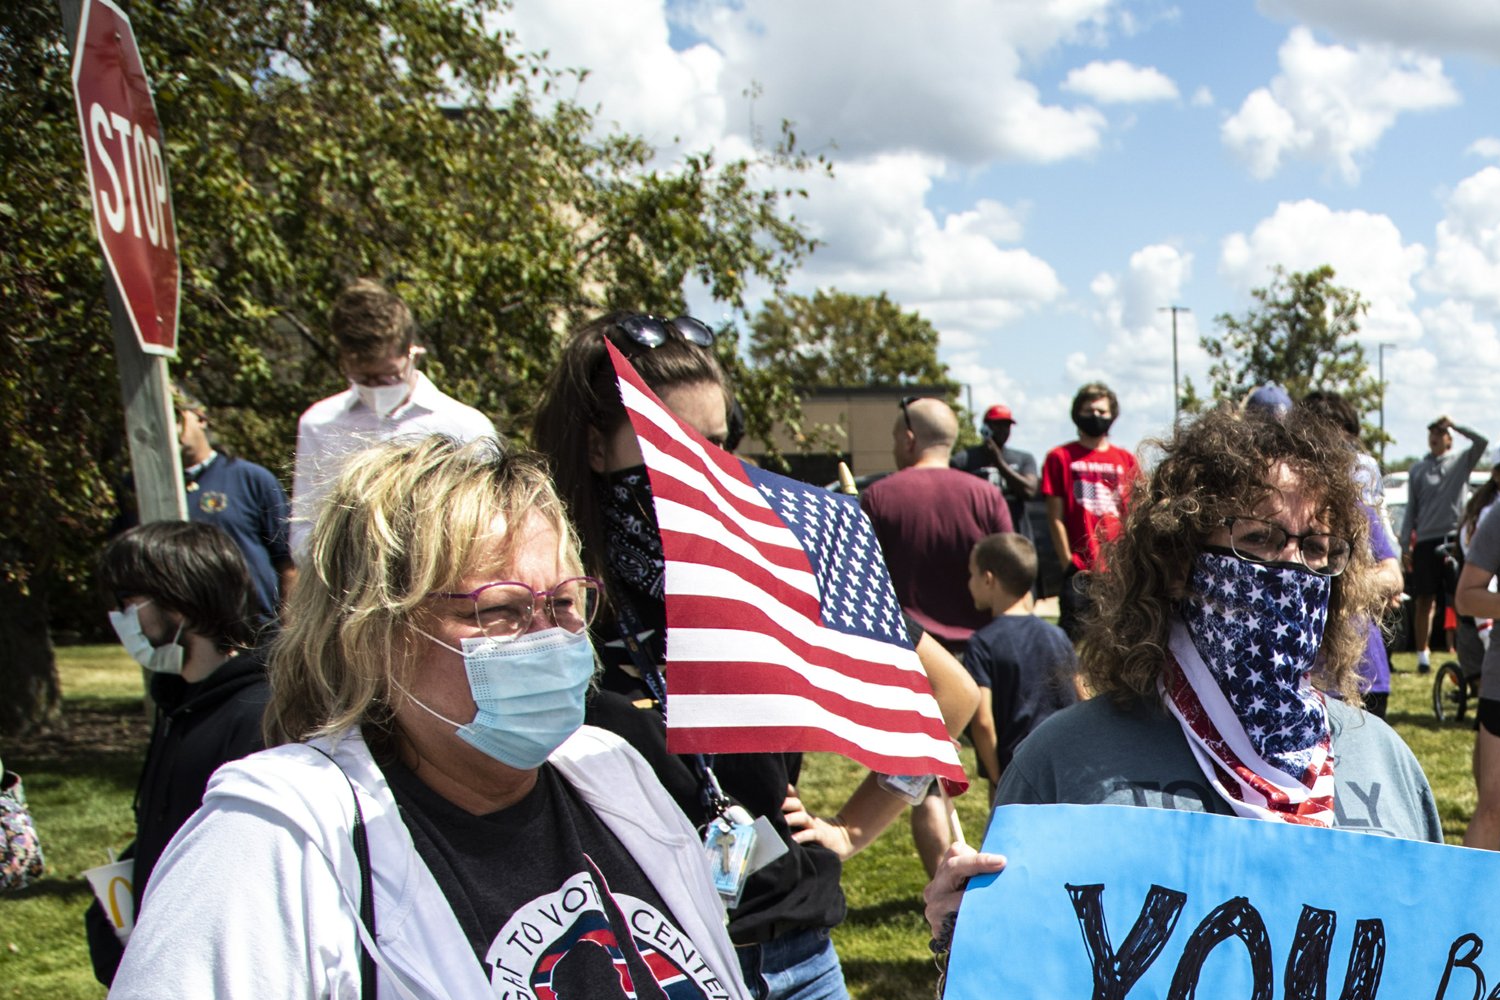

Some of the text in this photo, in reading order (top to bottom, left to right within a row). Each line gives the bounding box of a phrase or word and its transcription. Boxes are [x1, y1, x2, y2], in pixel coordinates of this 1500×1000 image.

[90, 102, 168, 250] STOP
[507, 922, 543, 956] TO
[538, 880, 600, 927] VOT
